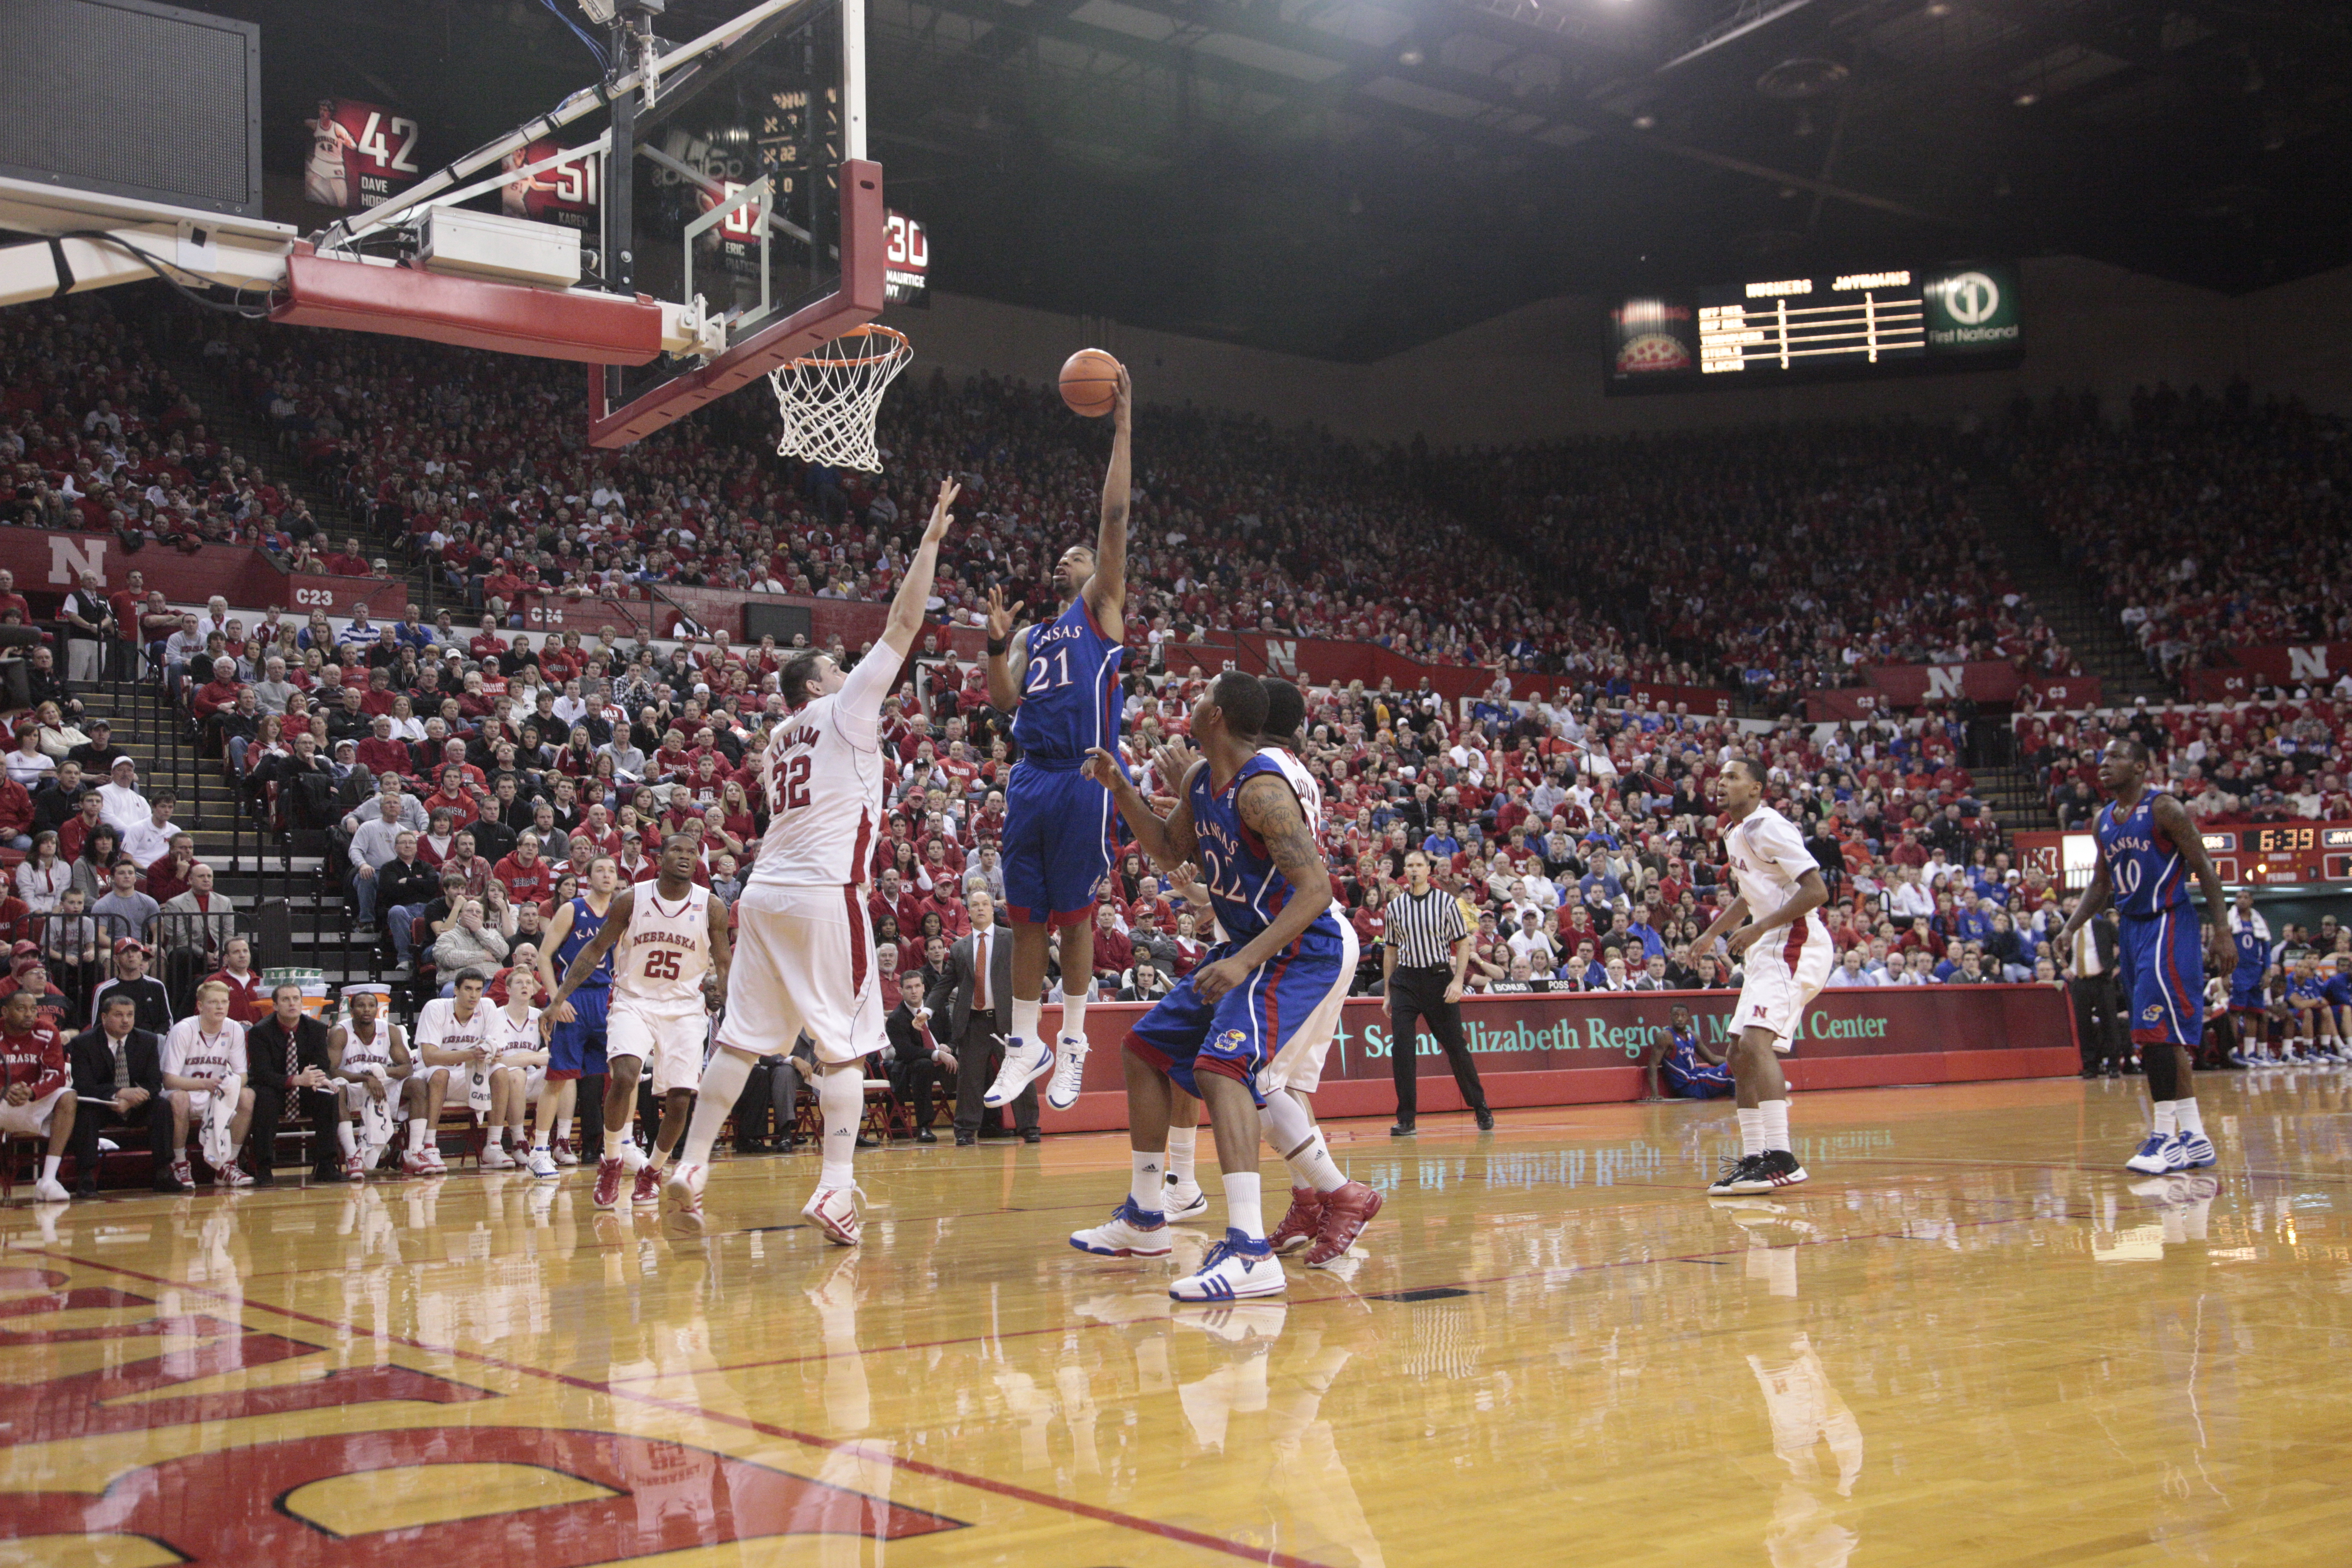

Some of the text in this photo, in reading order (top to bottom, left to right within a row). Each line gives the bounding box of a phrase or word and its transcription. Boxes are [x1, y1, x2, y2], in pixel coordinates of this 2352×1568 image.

[358, 112, 418, 173] 42
[361, 176, 388, 193] DAVE
[557, 147, 596, 205] 51
[559, 211, 588, 227] KAREN
[725, 241, 745, 256] ERIC
[888, 215, 928, 267] 30
[886, 269, 925, 288] MAURTICE
[886, 284, 899, 297] IVY
[1957, 325, 2019, 342] National
[48, 536, 107, 587] N
[297, 588, 333, 606] C23
[1266, 640, 1297, 676] N
[2288, 645, 2329, 680] N
[1026, 647, 1073, 694] 21
[1928, 666, 1963, 698] N
[2224, 677, 2244, 689] C4
[1558, 685, 1571, 697] C1
[1637, 692, 1650, 704] C2
[2048, 686, 2067, 699] C3
[601, 710, 619, 718] NU
[948, 765, 970, 776] NEBRASKA
[772, 754, 811, 815] 32
[1195, 820, 1239, 855] KANSAS
[2259, 828, 2314, 852] 6:39
[2104, 836, 2151, 862] KANSAS
[2268, 853, 2292, 861] BONUS
[512, 878, 539, 887] NEBRASKA
[1205, 849, 1247, 903] 22
[2113, 859, 2141, 895] 10
[2266, 872, 2297, 882] PERIOD
[575, 926, 601, 940] KAN
[633, 931, 696, 952] NEBRASKA
[2242, 934, 2253, 949] 0
[644, 950, 682, 980] 25
[1494, 983, 1527, 992] BONUS
[1548, 980, 1569, 990] POSS
[1753, 1005, 1768, 1019] N
[1810, 1011, 1888, 1040] Center
[184, 1056, 227, 1067] NEBRASKA
[345, 1054, 387, 1065] NEBRASKA
